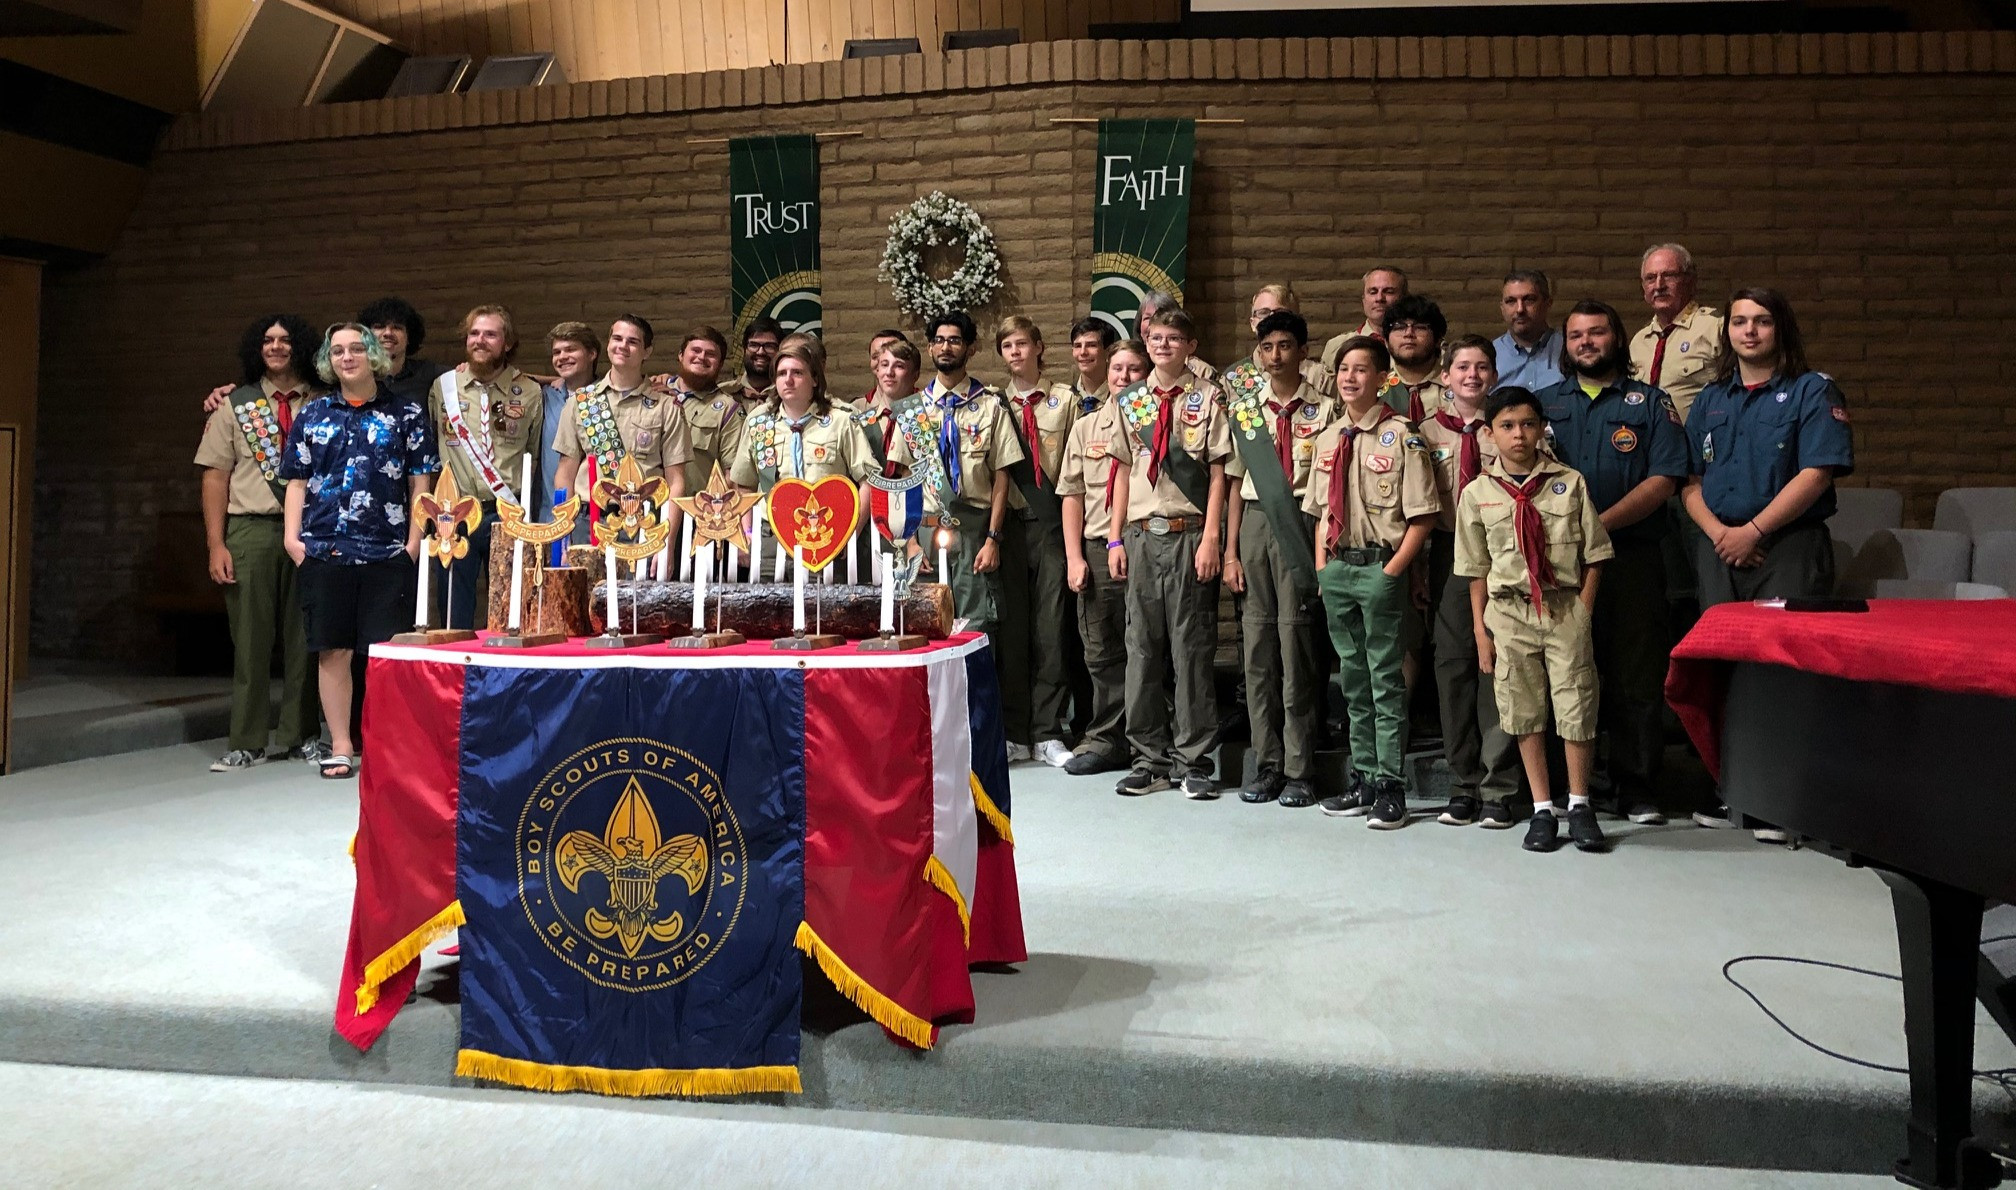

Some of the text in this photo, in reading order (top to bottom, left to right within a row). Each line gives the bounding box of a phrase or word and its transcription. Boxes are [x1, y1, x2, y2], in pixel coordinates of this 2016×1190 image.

[1101, 155, 1185, 210] FAITH
[734, 193, 814, 238] TRUST
[870, 474, 923, 489] BE PREPARED
[506, 520, 569, 539] BE PREPARED
[615, 540, 660, 556] PREPARED
[527, 749, 736, 887] BOY SCOUTS OF AMERICA
[547, 921, 711, 981] BE PREPARED
